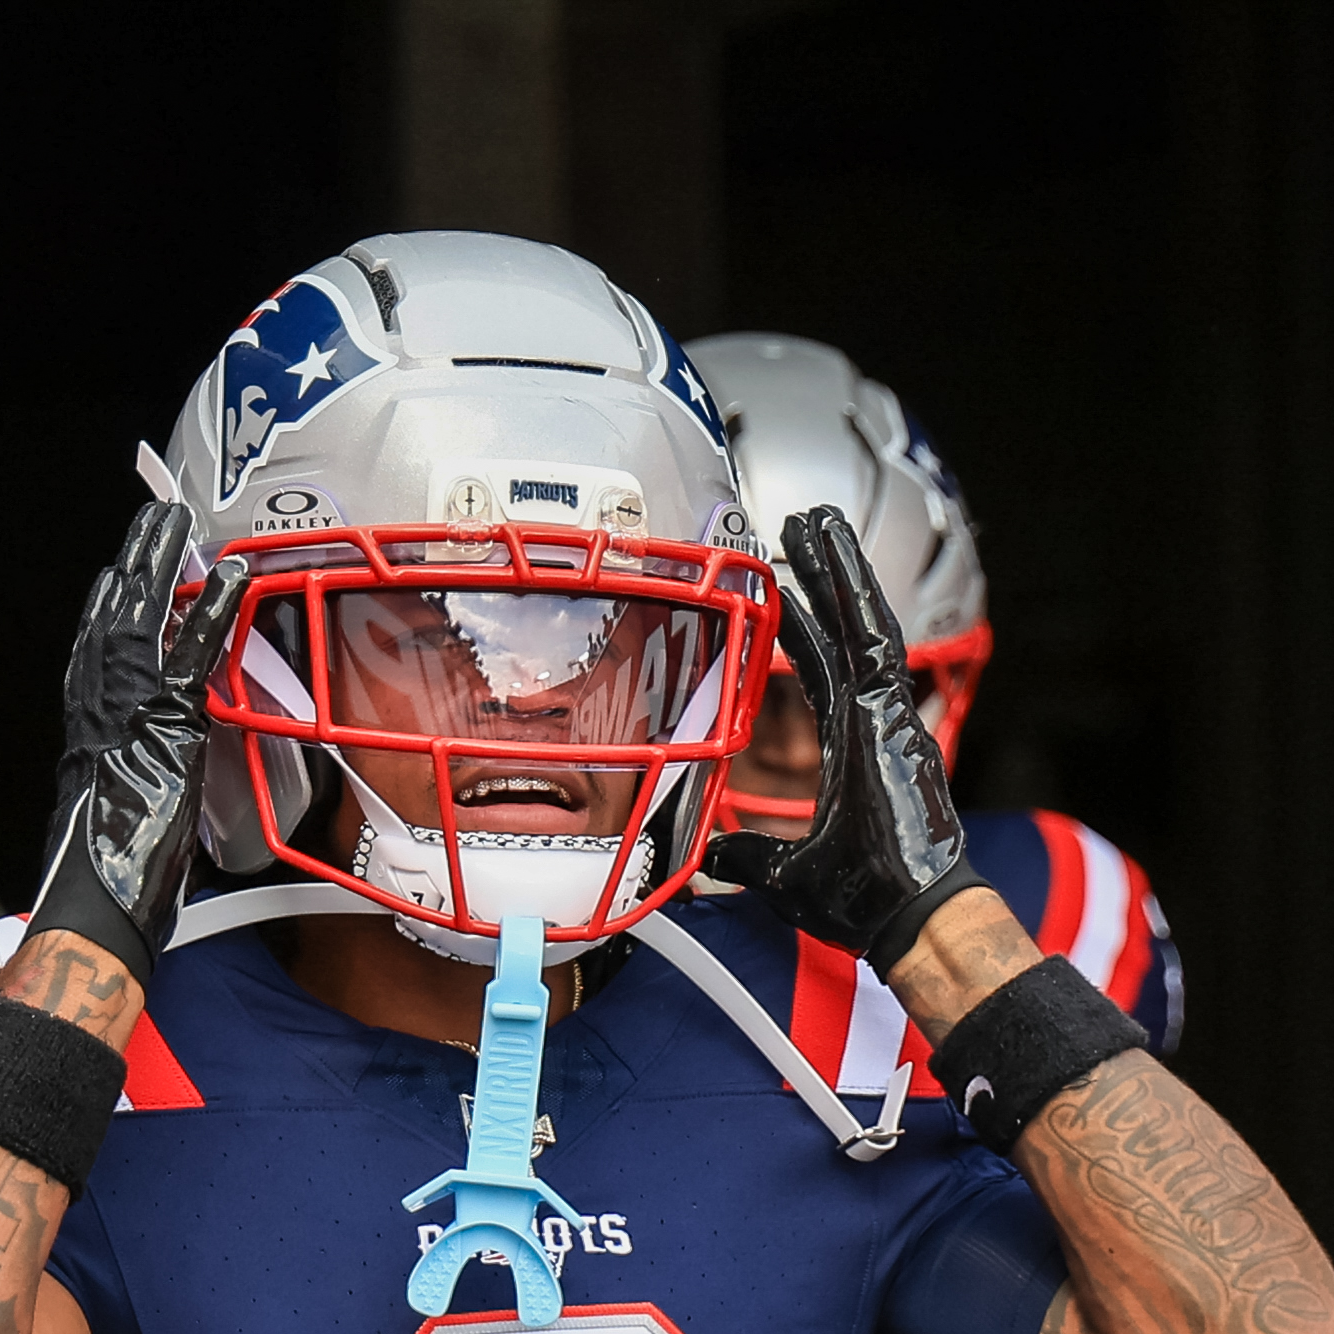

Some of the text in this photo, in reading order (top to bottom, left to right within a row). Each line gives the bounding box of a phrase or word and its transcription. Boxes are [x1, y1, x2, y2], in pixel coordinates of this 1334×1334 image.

[509, 479, 579, 509] PATRIOTS
[254, 515, 331, 532] OAKLEY
[478, 1031, 536, 1161] NXTRND
[417, 1213, 633, 1256] POTS
